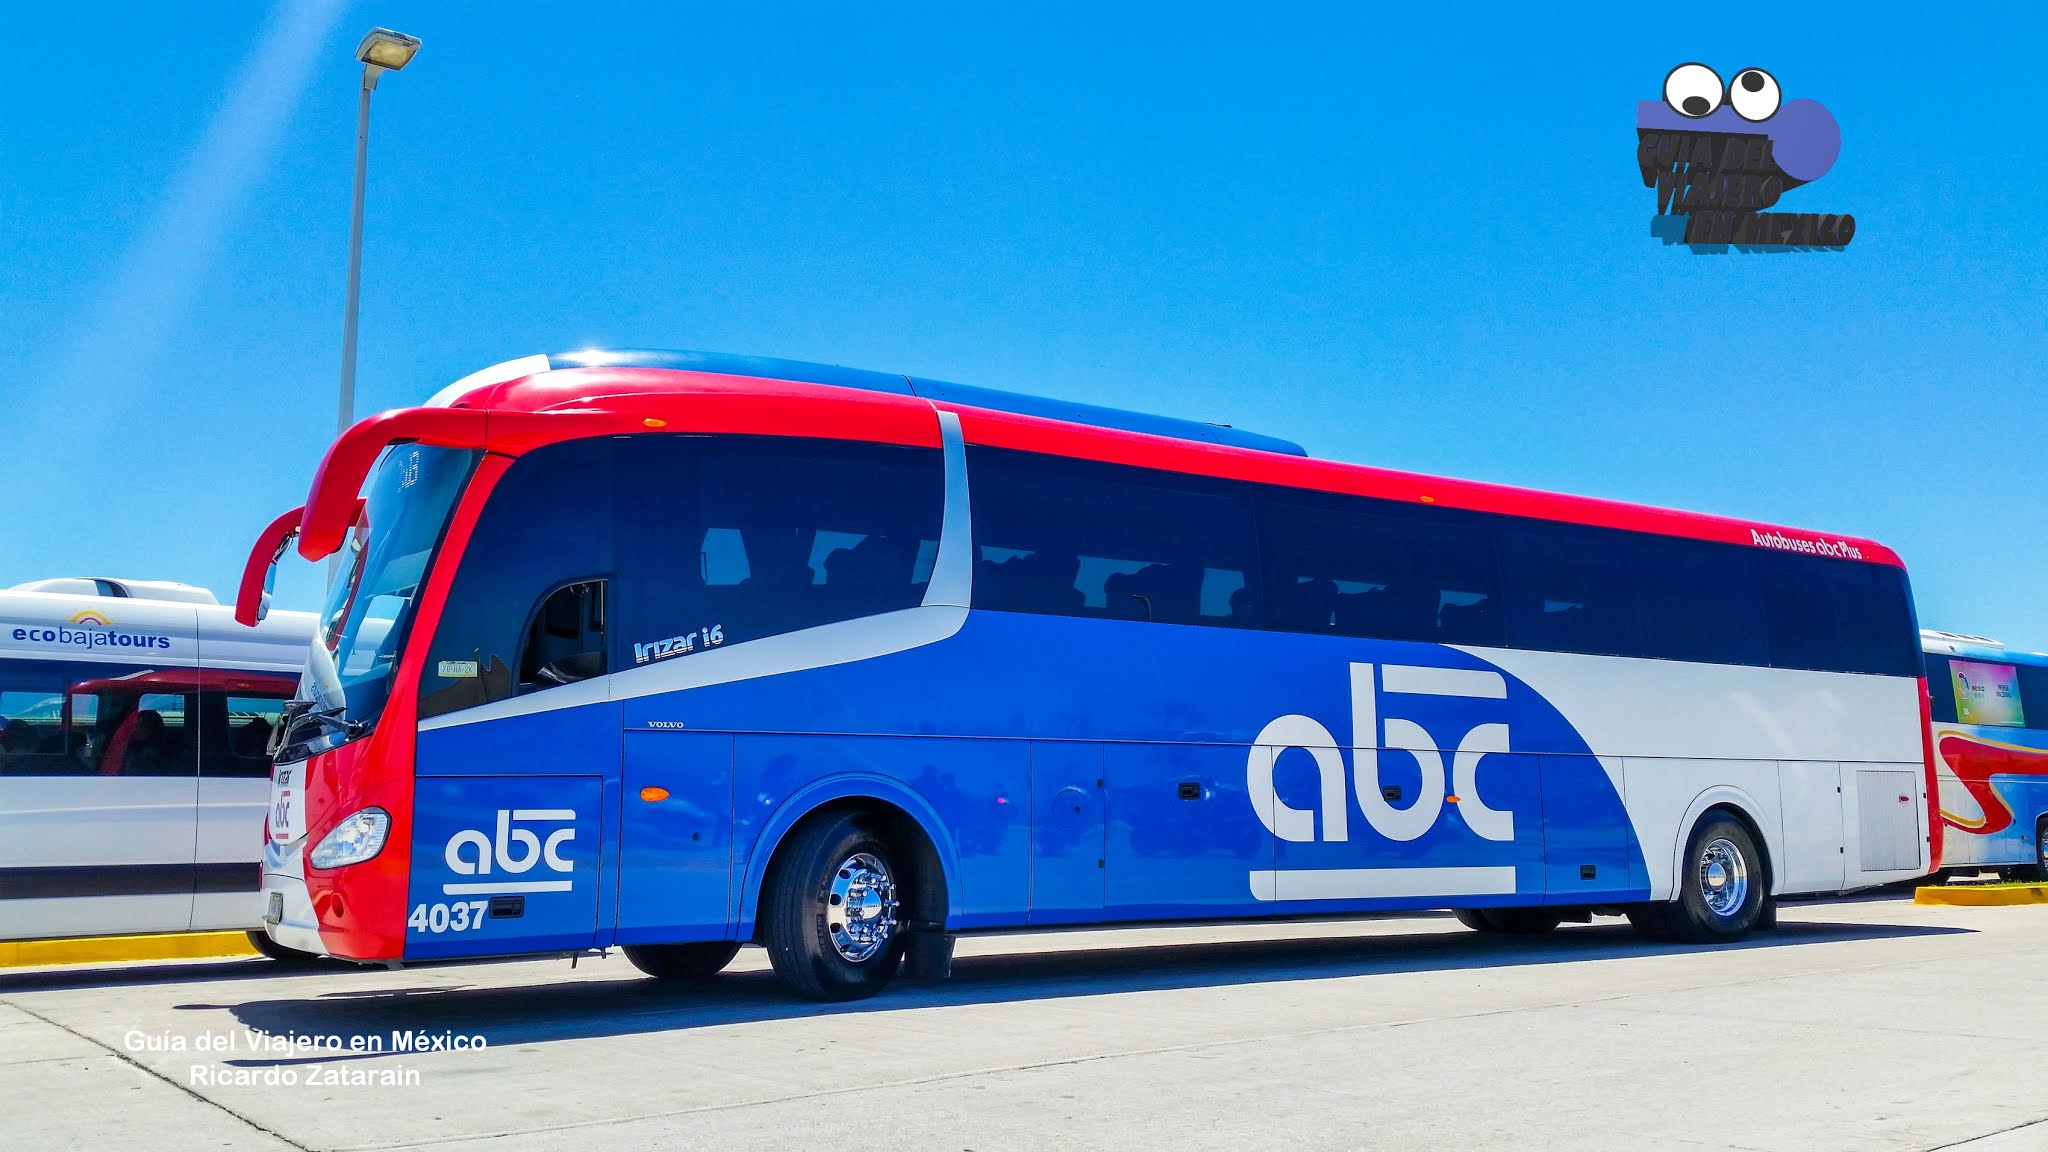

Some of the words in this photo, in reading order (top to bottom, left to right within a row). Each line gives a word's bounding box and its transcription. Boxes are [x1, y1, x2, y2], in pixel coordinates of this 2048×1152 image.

[1750, 528, 1817, 554] Autobuses
[1815, 537, 1842, 557] abc
[1839, 540, 1863, 560] Plus
[12, 626, 171, 649] ecobajatours
[634, 632, 698, 664] Irizar
[702, 623, 724, 648] i6
[647, 721, 684, 729] VOLVO
[1246, 661, 1516, 843] abc
[445, 809, 576, 875] abc
[407, 901, 489, 934] 4037
